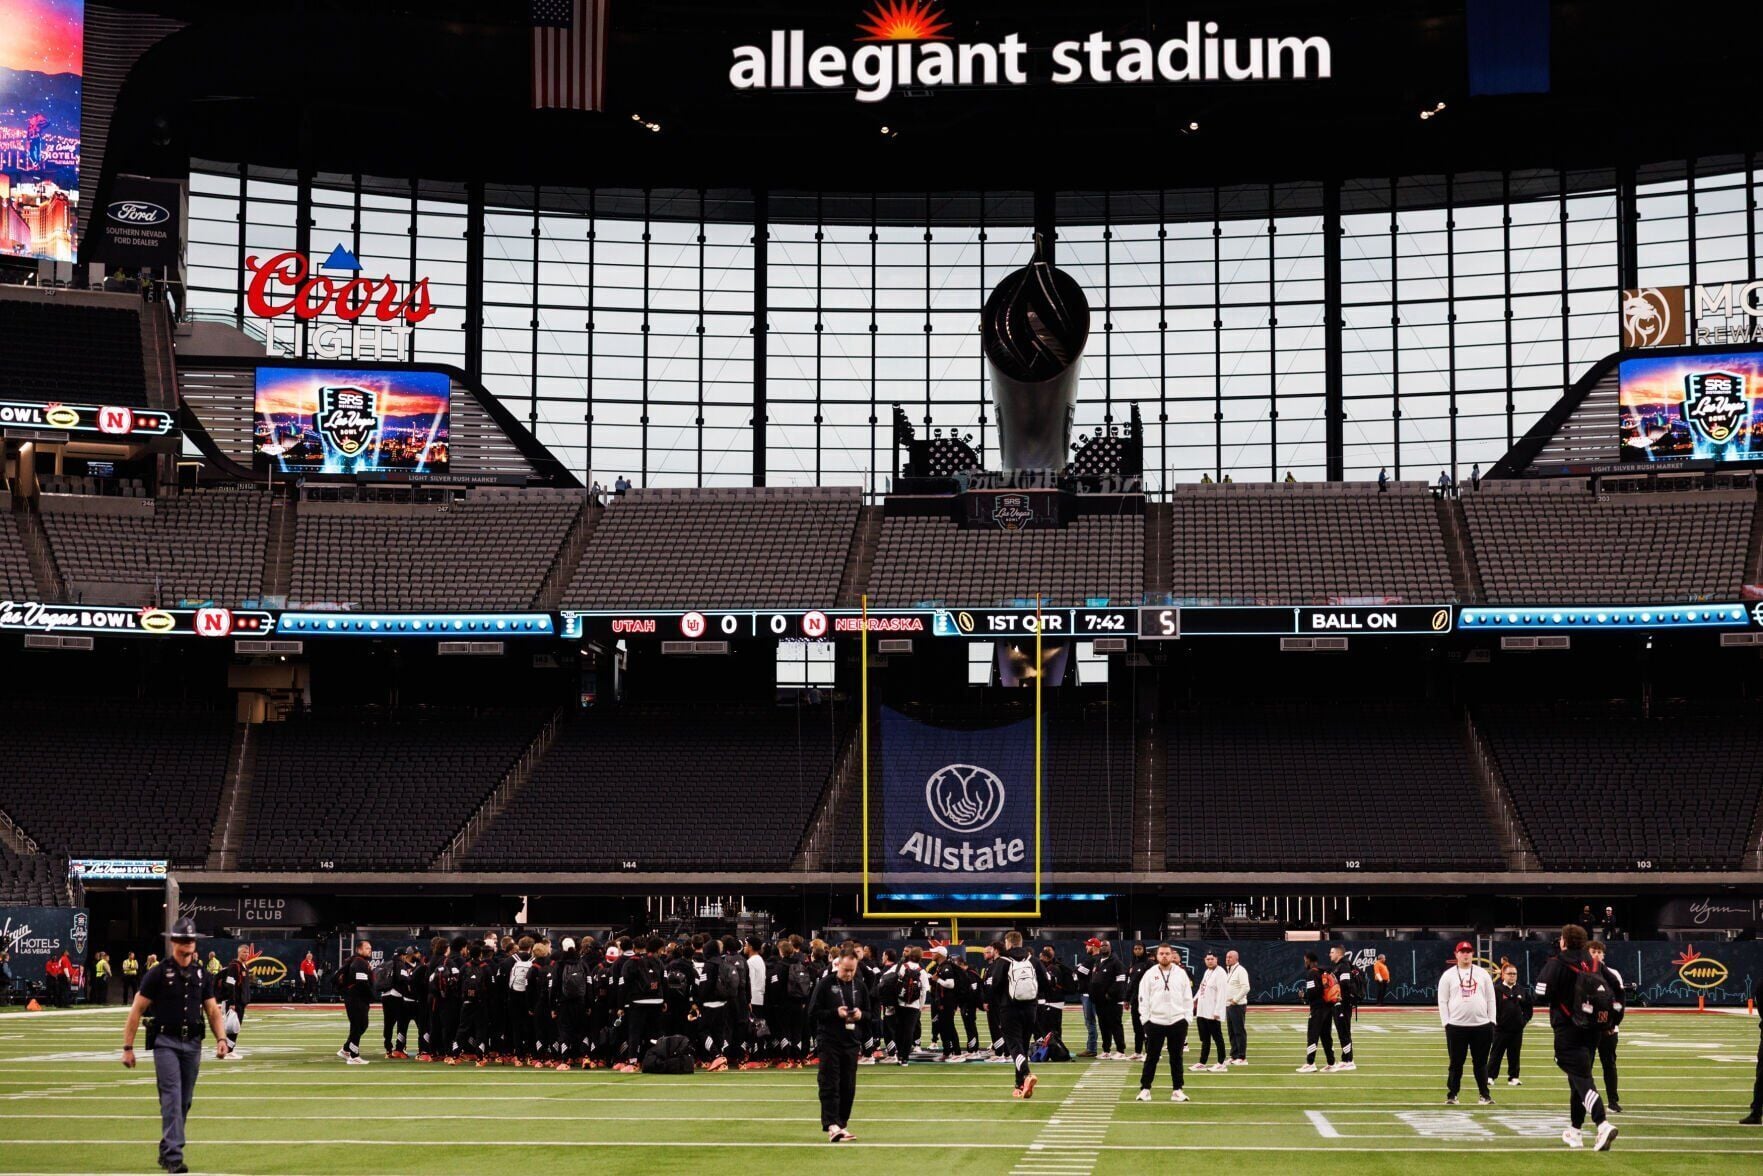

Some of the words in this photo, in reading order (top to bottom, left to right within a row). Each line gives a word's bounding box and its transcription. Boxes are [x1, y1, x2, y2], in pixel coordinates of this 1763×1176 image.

[729, 30, 1027, 101] allegiant
[1051, 21, 1331, 83] stadium
[118, 203, 156, 221] Ford
[106, 227, 140, 236] SOUTHERN
[141, 229, 167, 238] NEVADA
[114, 236, 131, 244] FORD
[132, 238, 158, 246] DEALERS
[246, 252, 436, 323] Coors
[266, 322, 413, 360] LIGHT
[1705, 379, 1731, 390] SRS
[338, 394, 363, 405] SRS
[1691, 396, 1716, 416] Las
[1715, 396, 1746, 417] Vegas
[107, 412, 124, 428] N
[324, 410, 348, 428] Las
[347, 411, 376, 431] Vegas
[995, 508, 1009, 517] Las
[1010, 508, 1030, 520] Vegas
[23, 602, 78, 632] Vegas
[81, 612, 136, 628] BOWL
[204, 614, 222, 630] N
[721, 615, 738, 634] 0
[770, 614, 787, 633] 0
[835, 618, 923, 631] NEBRASKA
[987, 615, 1018, 630] 1ST
[1022, 615, 1062, 632] QTR
[1085, 615, 1125, 630] 7:42
[1312, 614, 1362, 628] BALL
[1367, 613, 1397, 628] ON
[612, 620, 656, 632] UTAH
[899, 831, 1024, 871] Allstate
[87, 863, 103, 874] Las
[102, 863, 126, 876] Vegas
[127, 866, 150, 874] BOWL
[244, 899, 286, 908] FIELD
[246, 910, 282, 920] CLUB
[21, 938, 59, 948] HOTELS
